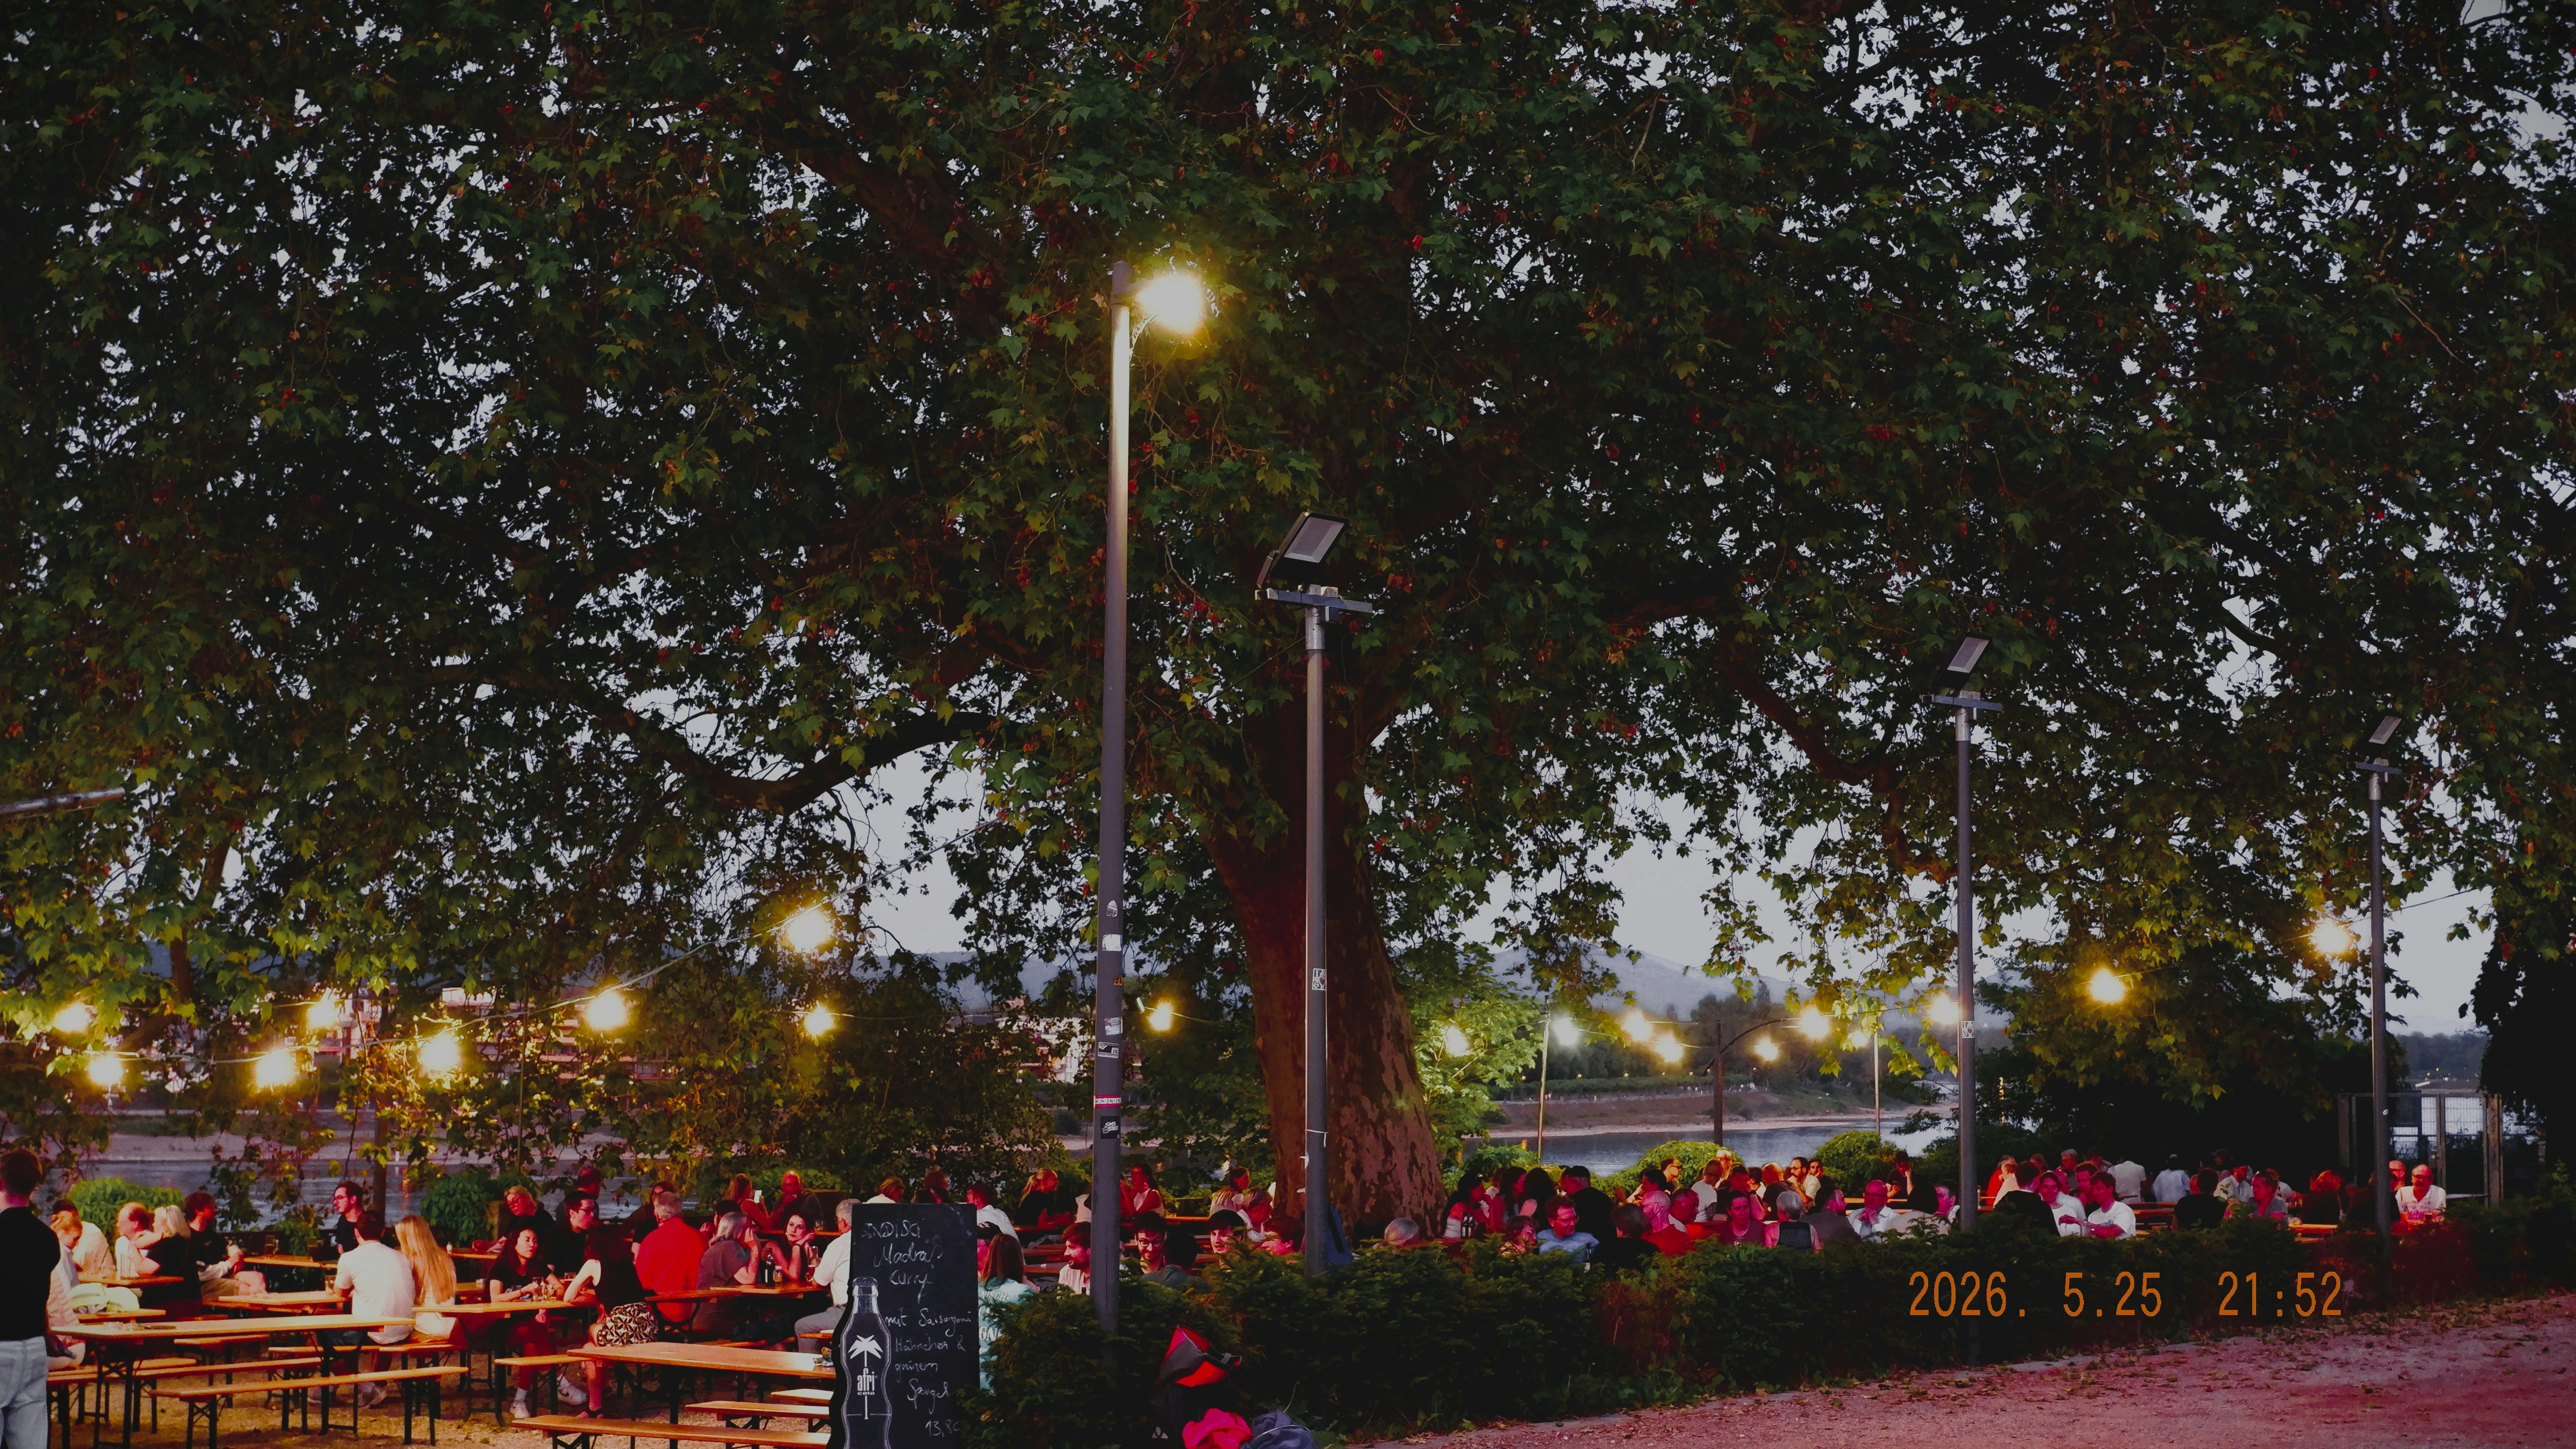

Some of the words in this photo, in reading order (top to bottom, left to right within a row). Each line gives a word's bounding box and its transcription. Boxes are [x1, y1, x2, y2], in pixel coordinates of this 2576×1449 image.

[889, 1269, 933, 1304] Curry
[957, 1335, 966, 1351] &
[857, 1368, 875, 1391] afri
